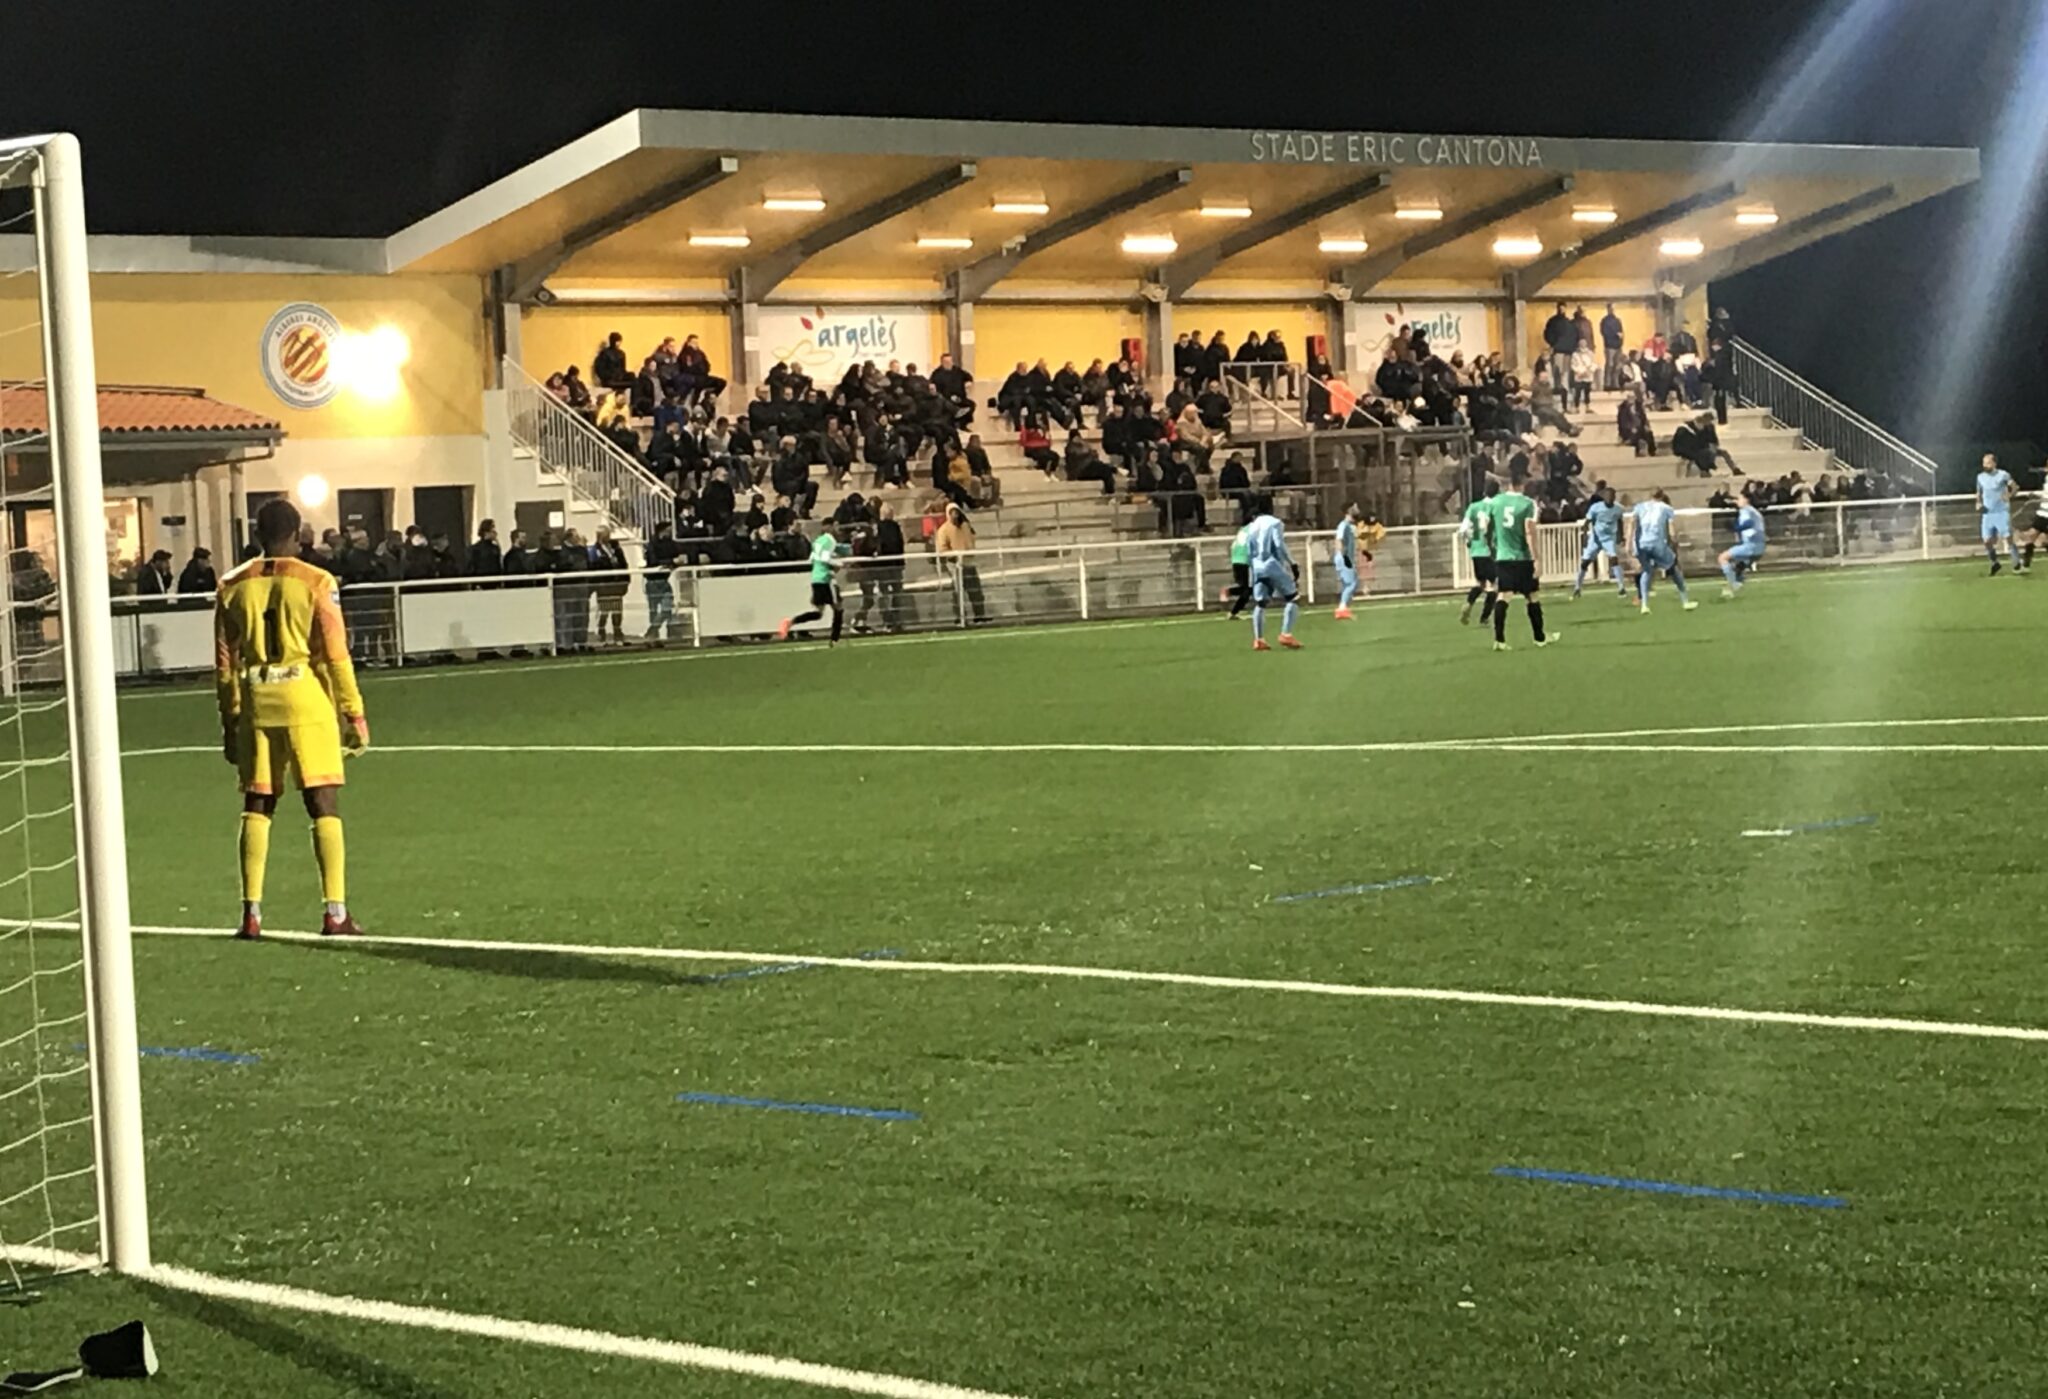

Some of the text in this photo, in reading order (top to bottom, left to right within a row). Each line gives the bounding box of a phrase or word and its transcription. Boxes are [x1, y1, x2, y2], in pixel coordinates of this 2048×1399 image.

[1252, 132, 1543, 167] STADE ERIC CANTONA
[818, 315, 897, 358] argelès
[1409, 312, 1462, 344] rgelès
[1502, 506, 1515, 528] 5
[262, 606, 282, 660] 1
